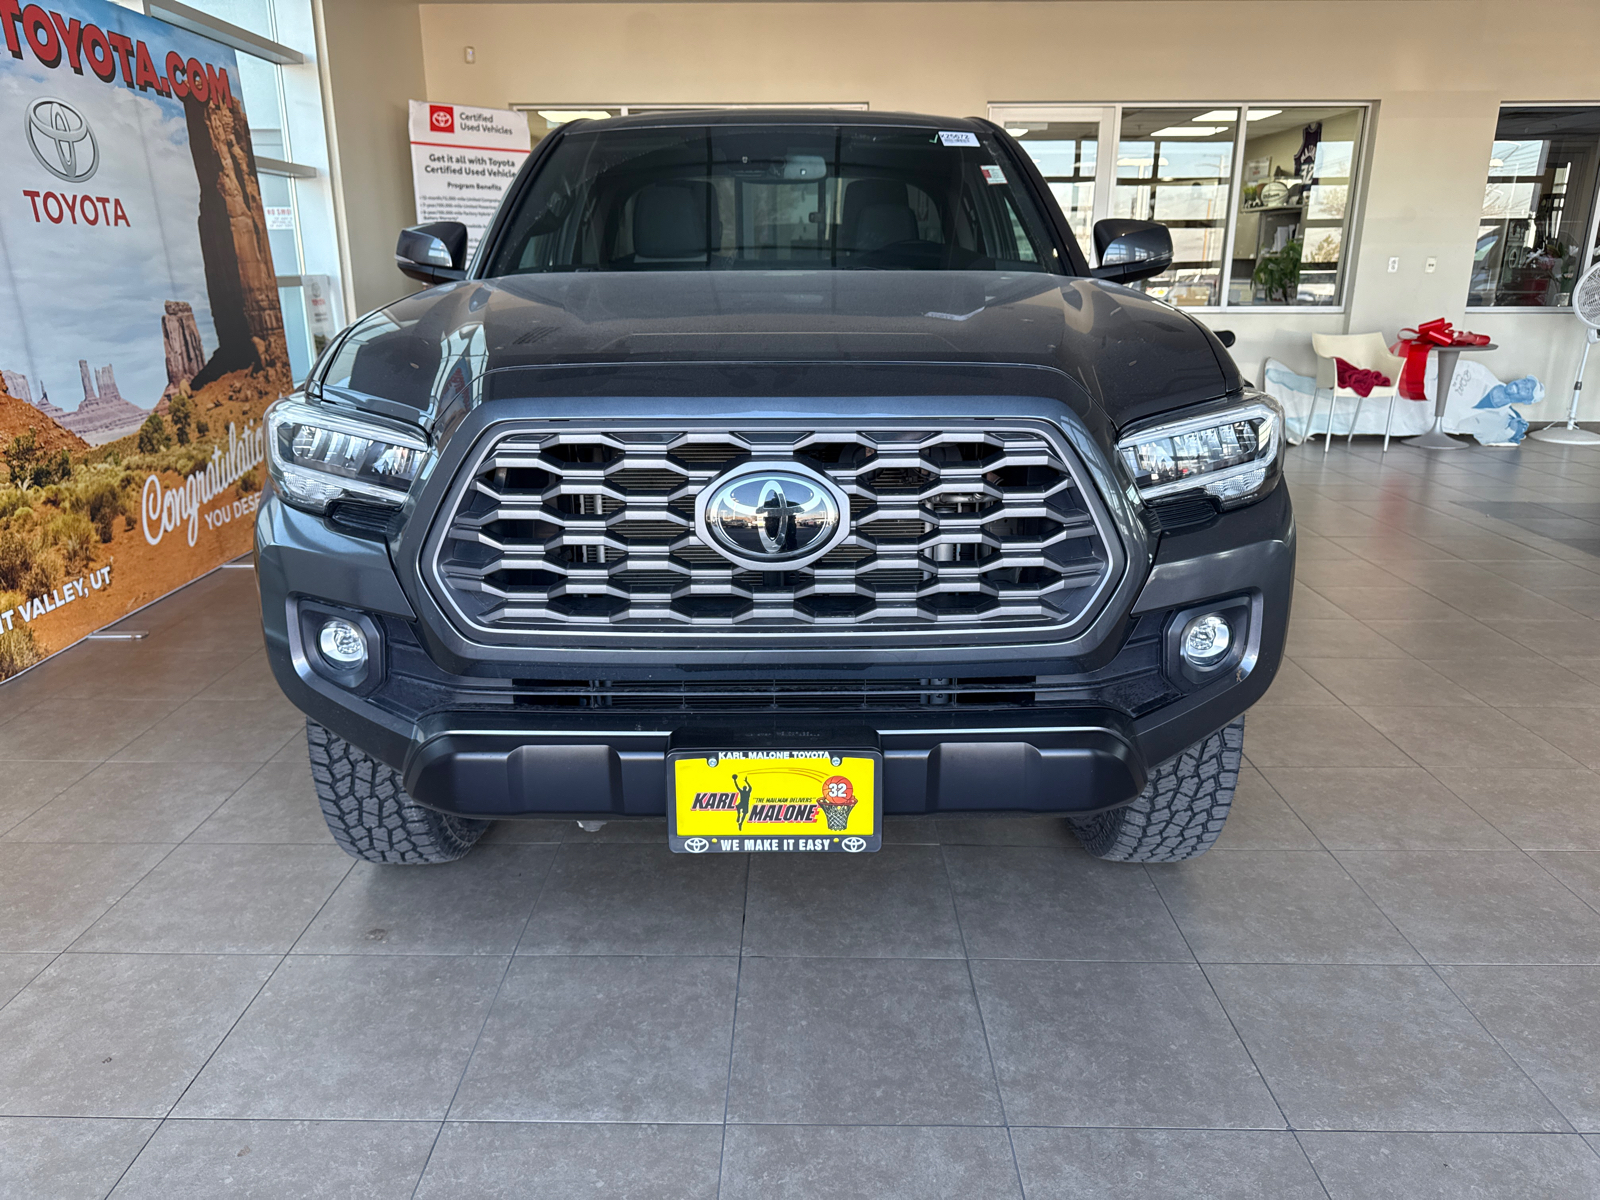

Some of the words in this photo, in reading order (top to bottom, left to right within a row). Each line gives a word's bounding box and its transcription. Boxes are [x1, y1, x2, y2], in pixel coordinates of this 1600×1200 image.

[460, 112, 493, 122] Certified
[460, 123, 480, 132] Used
[482, 125, 513, 135] Vehicles
[429, 153, 445, 163] Get
[447, 154, 453, 163] it
[455, 156, 466, 164] all
[468, 157, 486, 166] with
[488, 158, 515, 168] Toyota
[425, 165, 463, 175] Certified
[464, 166, 485, 176] Used
[487, 168, 517, 178] Vehicle
[447, 182, 475, 192] Program
[476, 183, 502, 191] Benefits
[23, 189, 131, 227] TOYOTA
[142, 419, 264, 547] Congratulatio
[204, 504, 231, 531] YOU
[233, 490, 262, 519] DESE
[18, 577, 89, 623] VALLEY,
[90, 565, 111, 590] UT
[719, 752, 746, 760] KARL
[749, 752, 790, 760] MALONE
[792, 751, 830, 759] TOYOTA
[828, 783, 847, 798] 32
[691, 792, 739, 811] KARL
[747, 804, 819, 823] MALONE
[720, 839, 739, 851] WE
[744, 839, 779, 851] MAKE
[783, 839, 795, 851] IT
[799, 839, 830, 851] EASY
